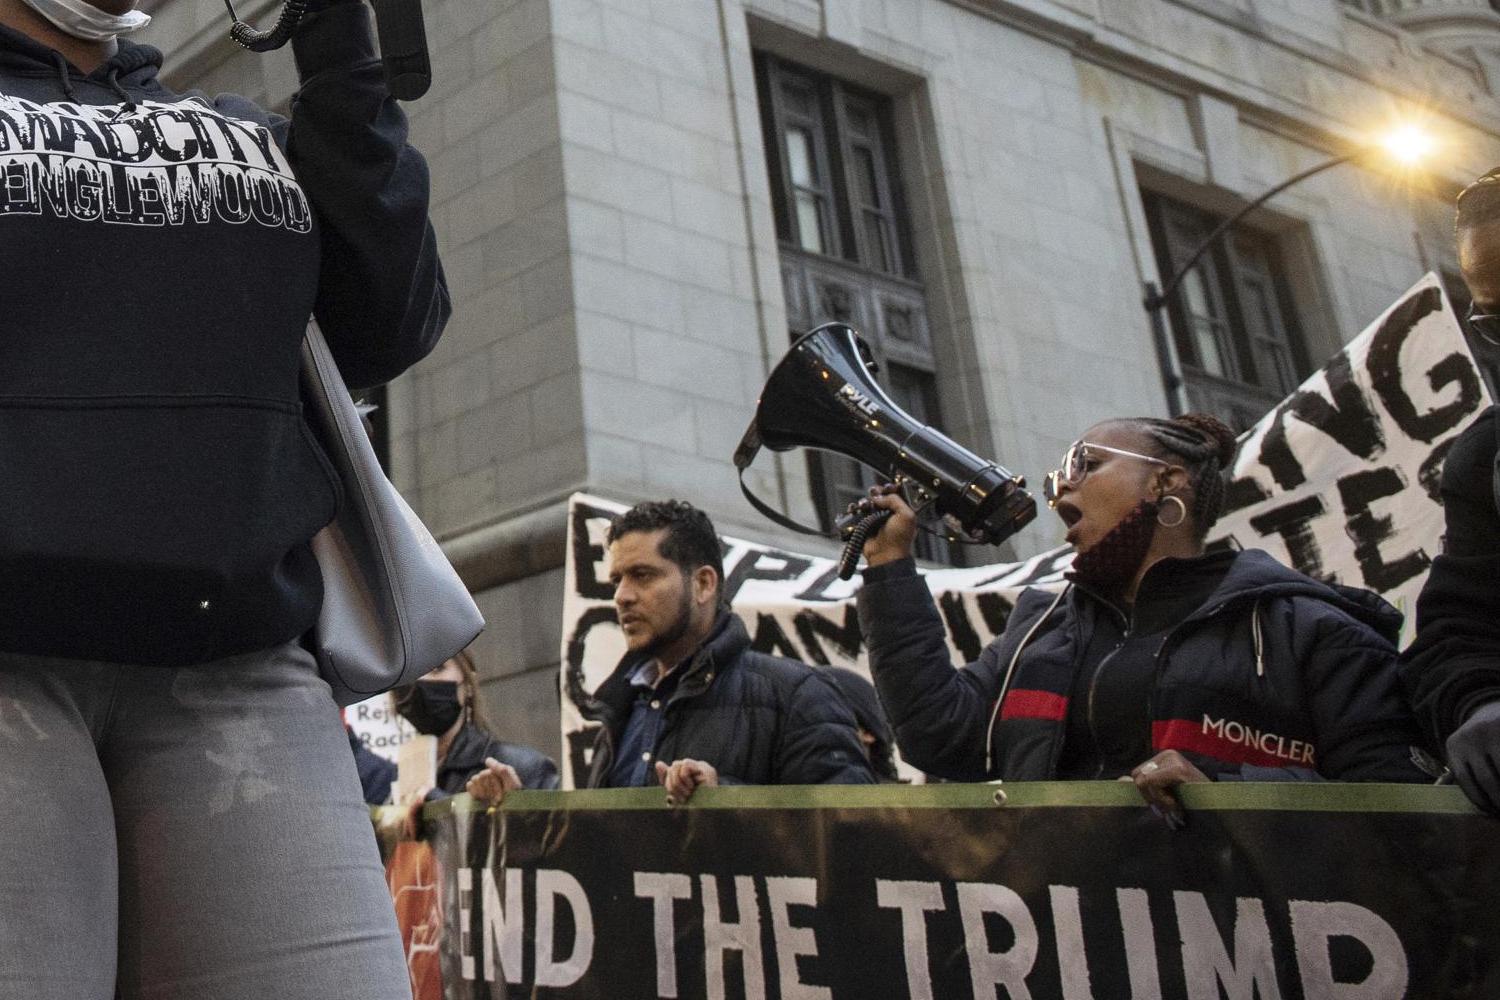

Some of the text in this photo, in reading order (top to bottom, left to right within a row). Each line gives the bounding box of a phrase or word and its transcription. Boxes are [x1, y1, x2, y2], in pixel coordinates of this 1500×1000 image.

[839, 382, 880, 416] PYLE
[1201, 713, 1315, 764] MONCLER
[456, 867, 1409, 1000] END THE TRUMP
